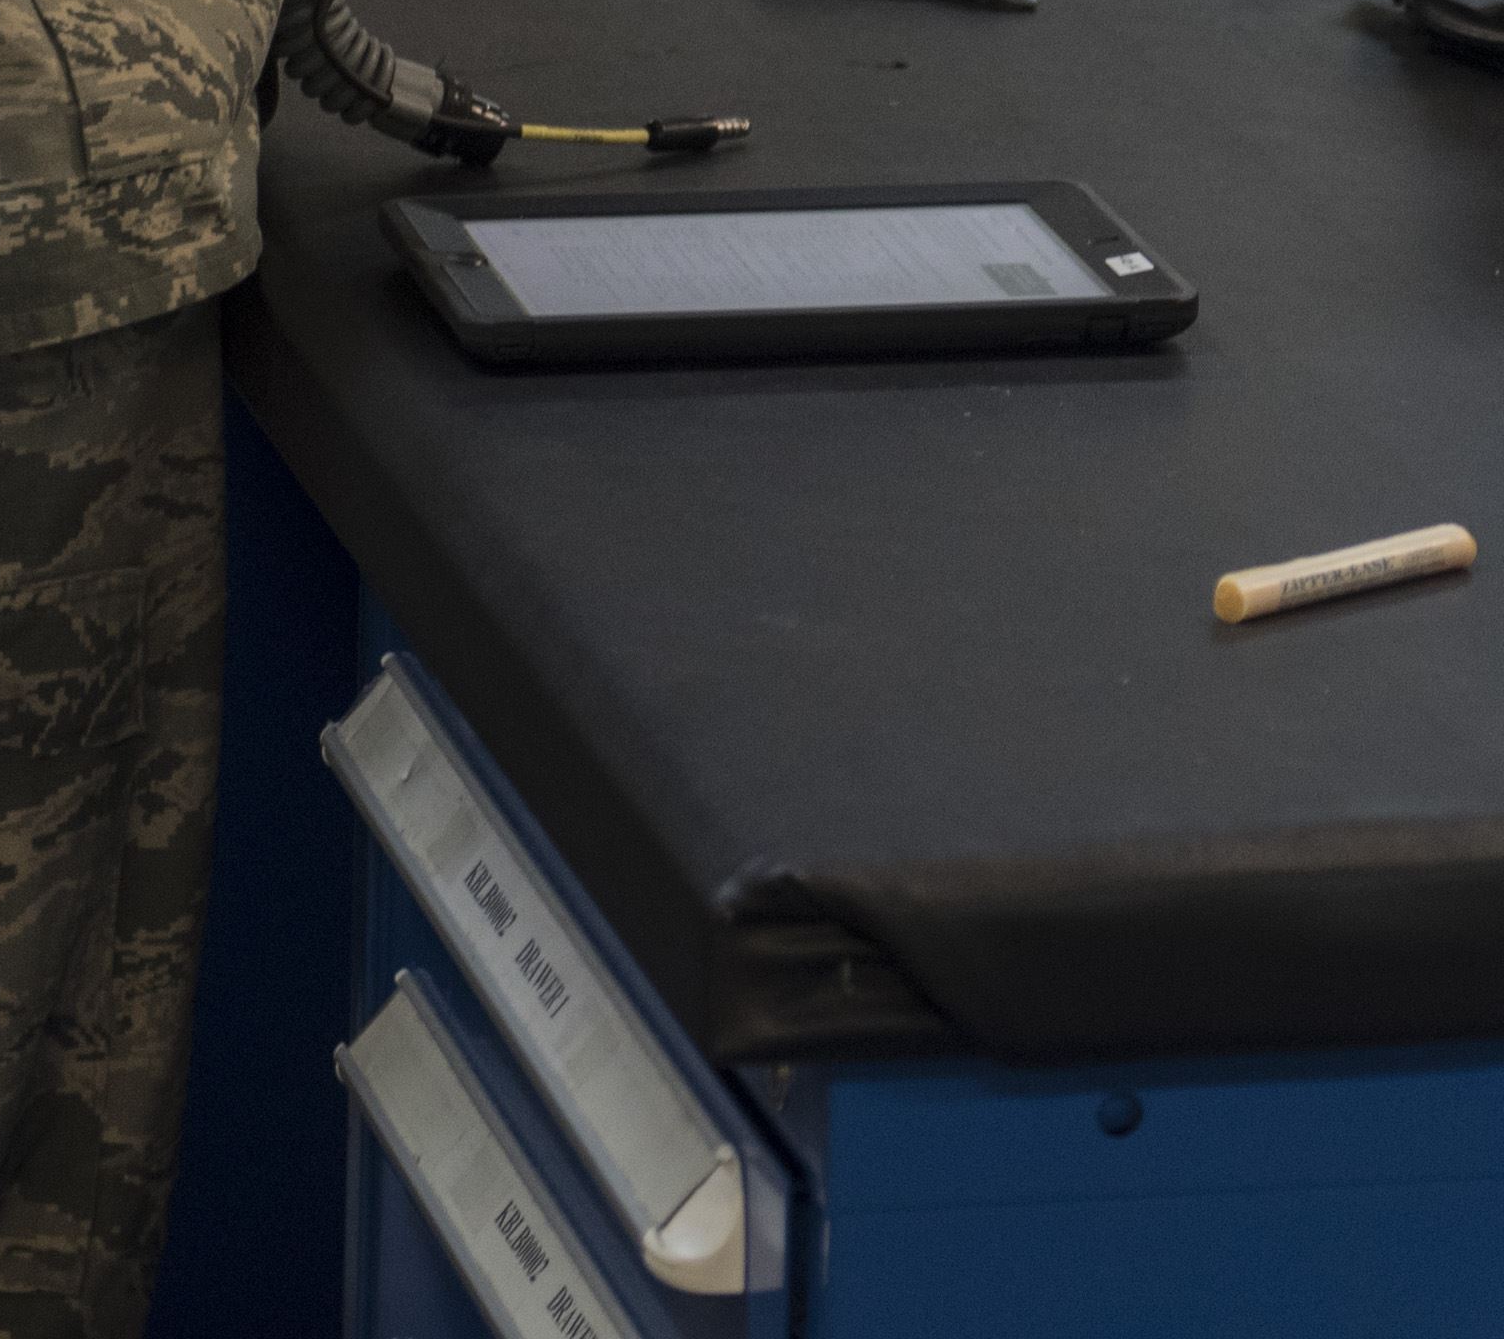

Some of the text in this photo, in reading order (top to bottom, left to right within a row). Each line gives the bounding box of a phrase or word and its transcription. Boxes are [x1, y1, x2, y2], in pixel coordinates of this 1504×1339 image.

[463, 859, 518, 937] KBLB00002
[515, 938, 565, 1012] DRAWER
[494, 1200, 550, 1283] KBLB00002
